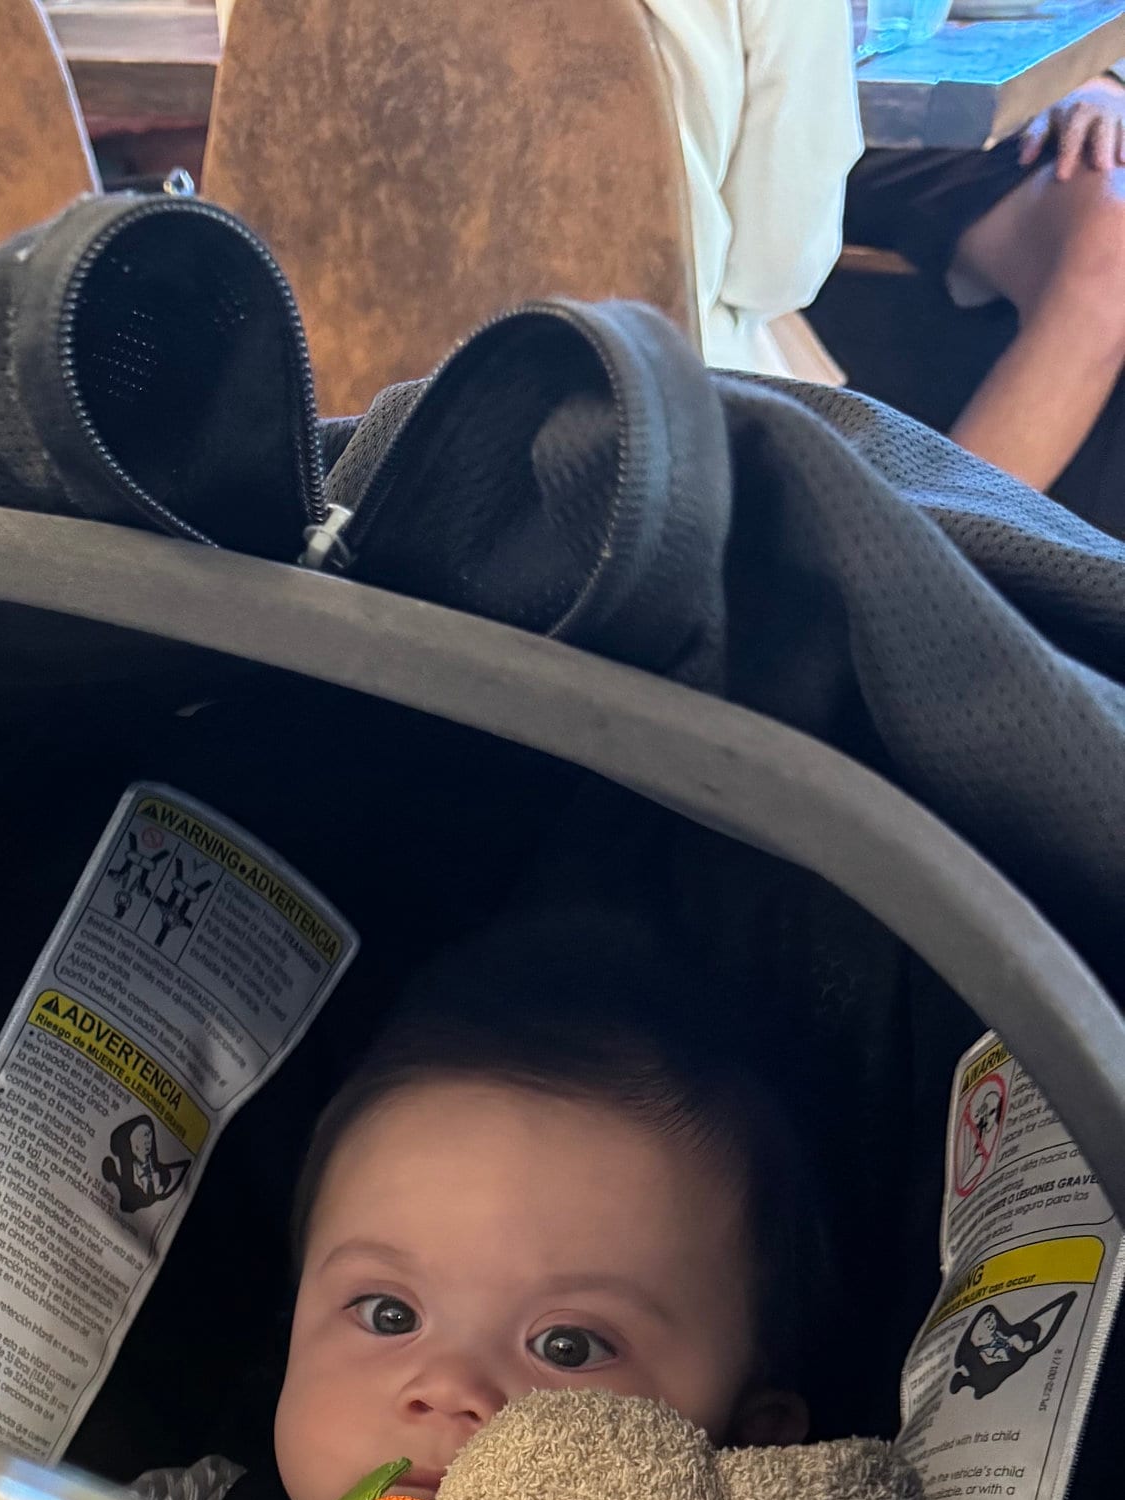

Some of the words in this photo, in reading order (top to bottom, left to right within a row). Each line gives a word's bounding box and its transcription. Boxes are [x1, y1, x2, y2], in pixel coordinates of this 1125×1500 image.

[157, 804, 242, 869] WARNING
[244, 866, 339, 957] ADVERTENCIA
[33, 1011, 73, 1040] Riesgo
[71, 1033, 86, 1047] de
[85, 1043, 125, 1078] MUERTE
[36, 1031, 75, 1060] Cuando
[61, 1002, 186, 1110] ADVERTENCIA
[26, 1054, 53, 1076] debe
[53, 1073, 87, 1099] colocar
[69, 1069, 83, 1081] en
[42, 1080, 56, 1092] en
[15, 1124, 36, 1140] que
[11, 1149, 25, 1163] de
[1058, 1173, 1100, 1190] GRAVE
[991, 1428, 1021, 1442] child
[993, 1464, 1026, 1478] child
[977, 1483, 1003, 1495] with
